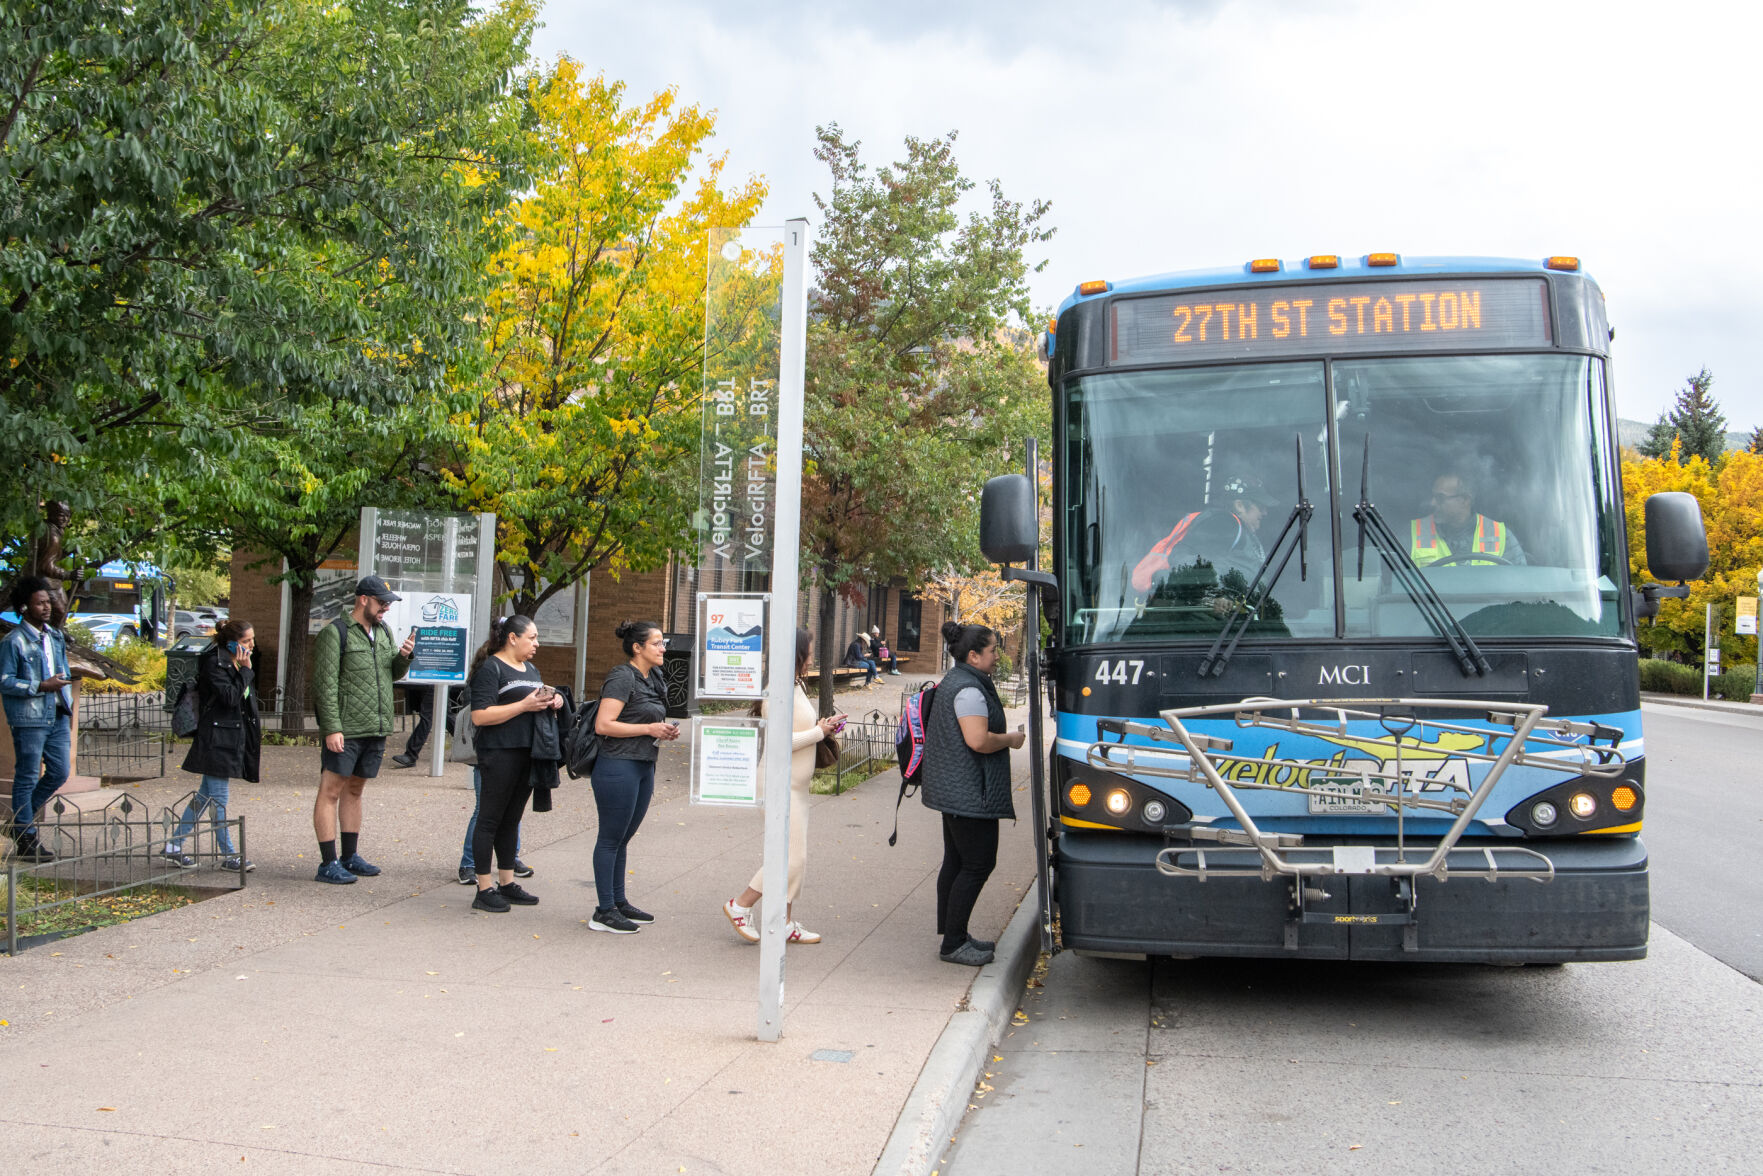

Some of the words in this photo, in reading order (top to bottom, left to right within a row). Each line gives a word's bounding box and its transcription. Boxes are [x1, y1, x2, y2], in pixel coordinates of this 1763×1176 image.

[792, 231, 798, 246] 1
[1173, 303, 1258, 343] 27TH
[1271, 299, 1313, 338] ST
[1327, 291, 1481, 335] STATION
[750, 376, 768, 415] BRT
[745, 442, 767, 560] VelociRFTA
[439, 604, 458, 615] ZERO
[439, 613, 458, 622] FARE
[711, 614, 724, 624] 97
[440, 629, 457, 637] FREE
[1095, 660, 1144, 685] 447
[1317, 665, 1372, 685] MCI
